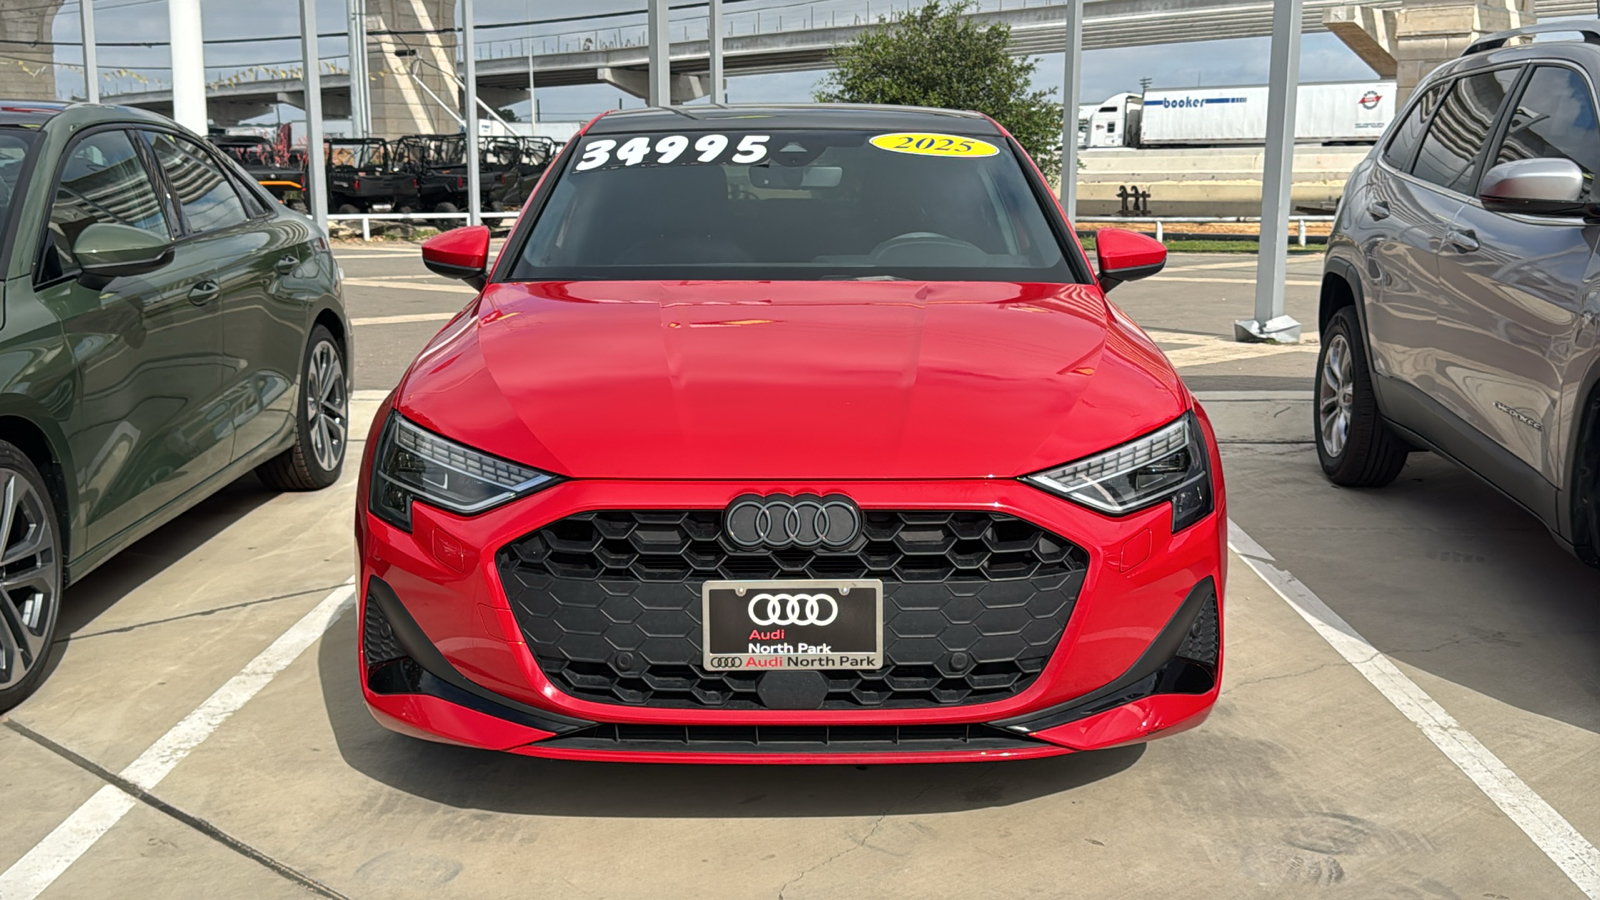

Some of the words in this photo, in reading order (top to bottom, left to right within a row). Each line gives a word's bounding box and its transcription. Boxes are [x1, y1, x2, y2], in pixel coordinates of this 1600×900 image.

[1163, 96, 1206, 108] booker
[893, 136, 976, 153] 2025
[575, 134, 770, 171] 34995
[749, 629, 786, 640] Audi
[748, 643, 794, 654] North
[798, 643, 832, 654] Park
[745, 656, 783, 667] Audi
[787, 656, 836, 667] North
[839, 655, 876, 667] Park
